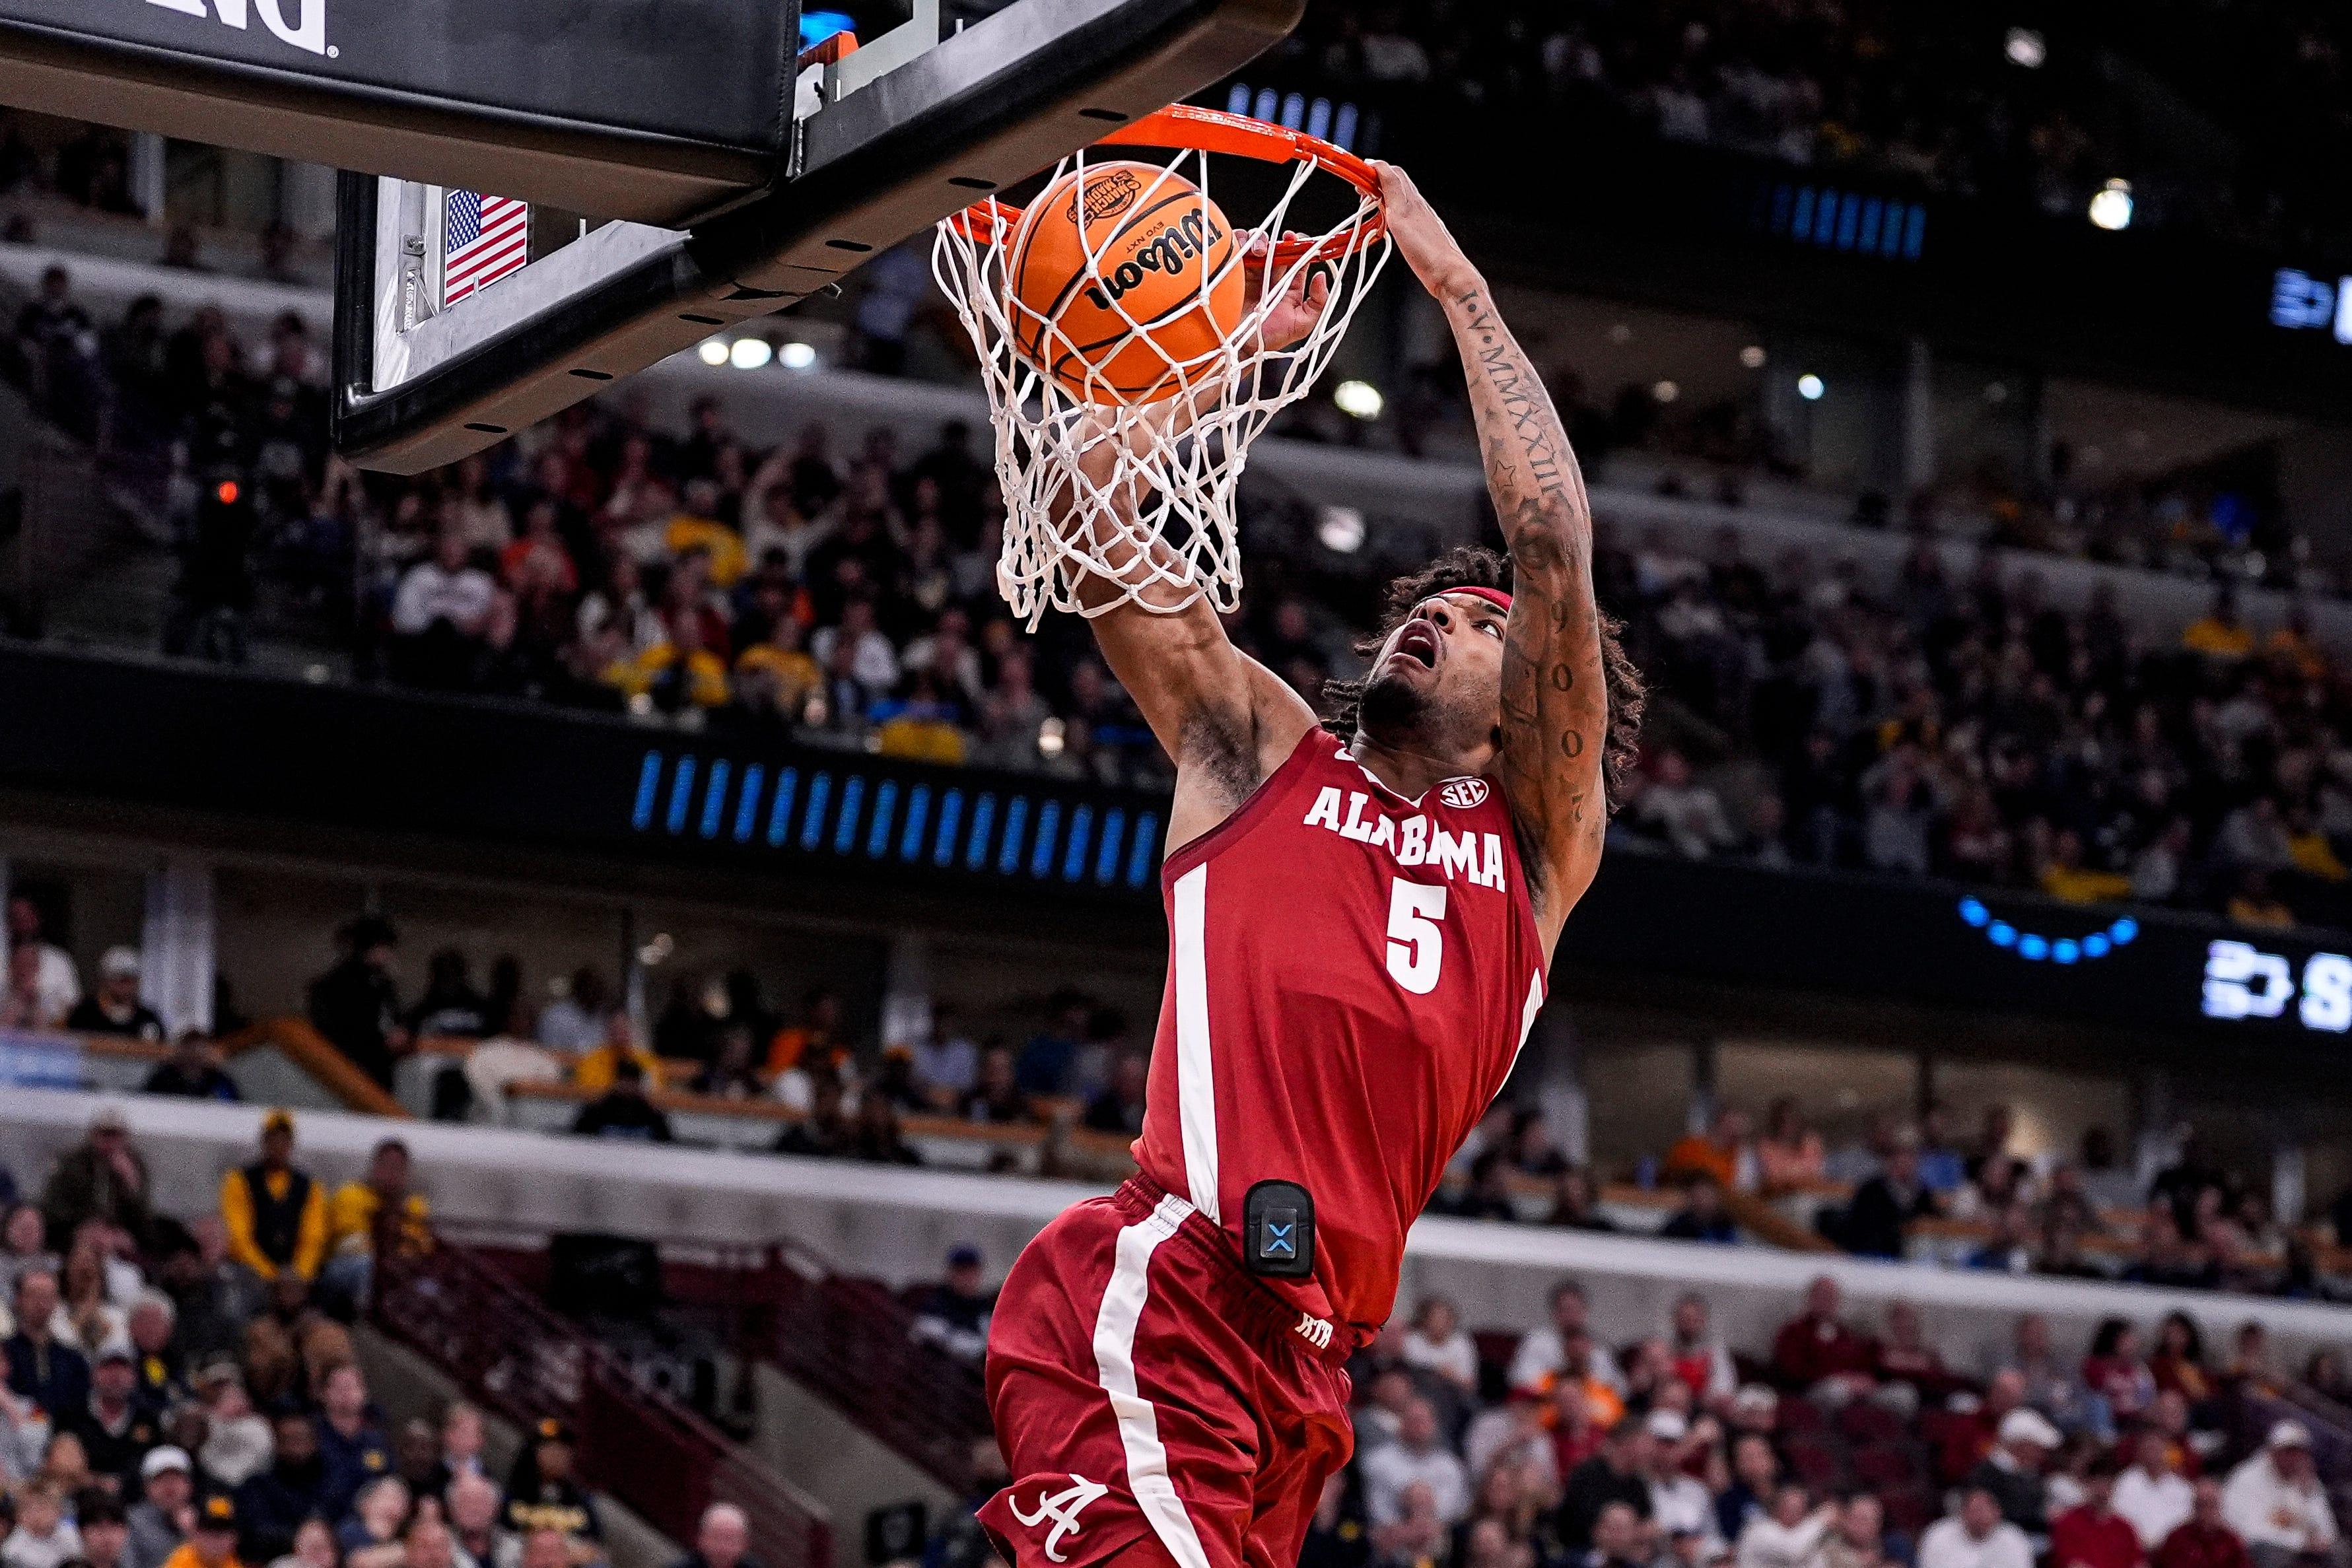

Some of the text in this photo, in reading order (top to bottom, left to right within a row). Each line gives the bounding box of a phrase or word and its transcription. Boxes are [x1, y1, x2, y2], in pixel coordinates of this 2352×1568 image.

[1090, 179, 1130, 214] MARCH
[1126, 221, 1165, 254] EVO NXT
[1084, 207, 1223, 310] Wilson
[1441, 780, 1485, 805] SEC
[1385, 876, 1447, 995] 5
